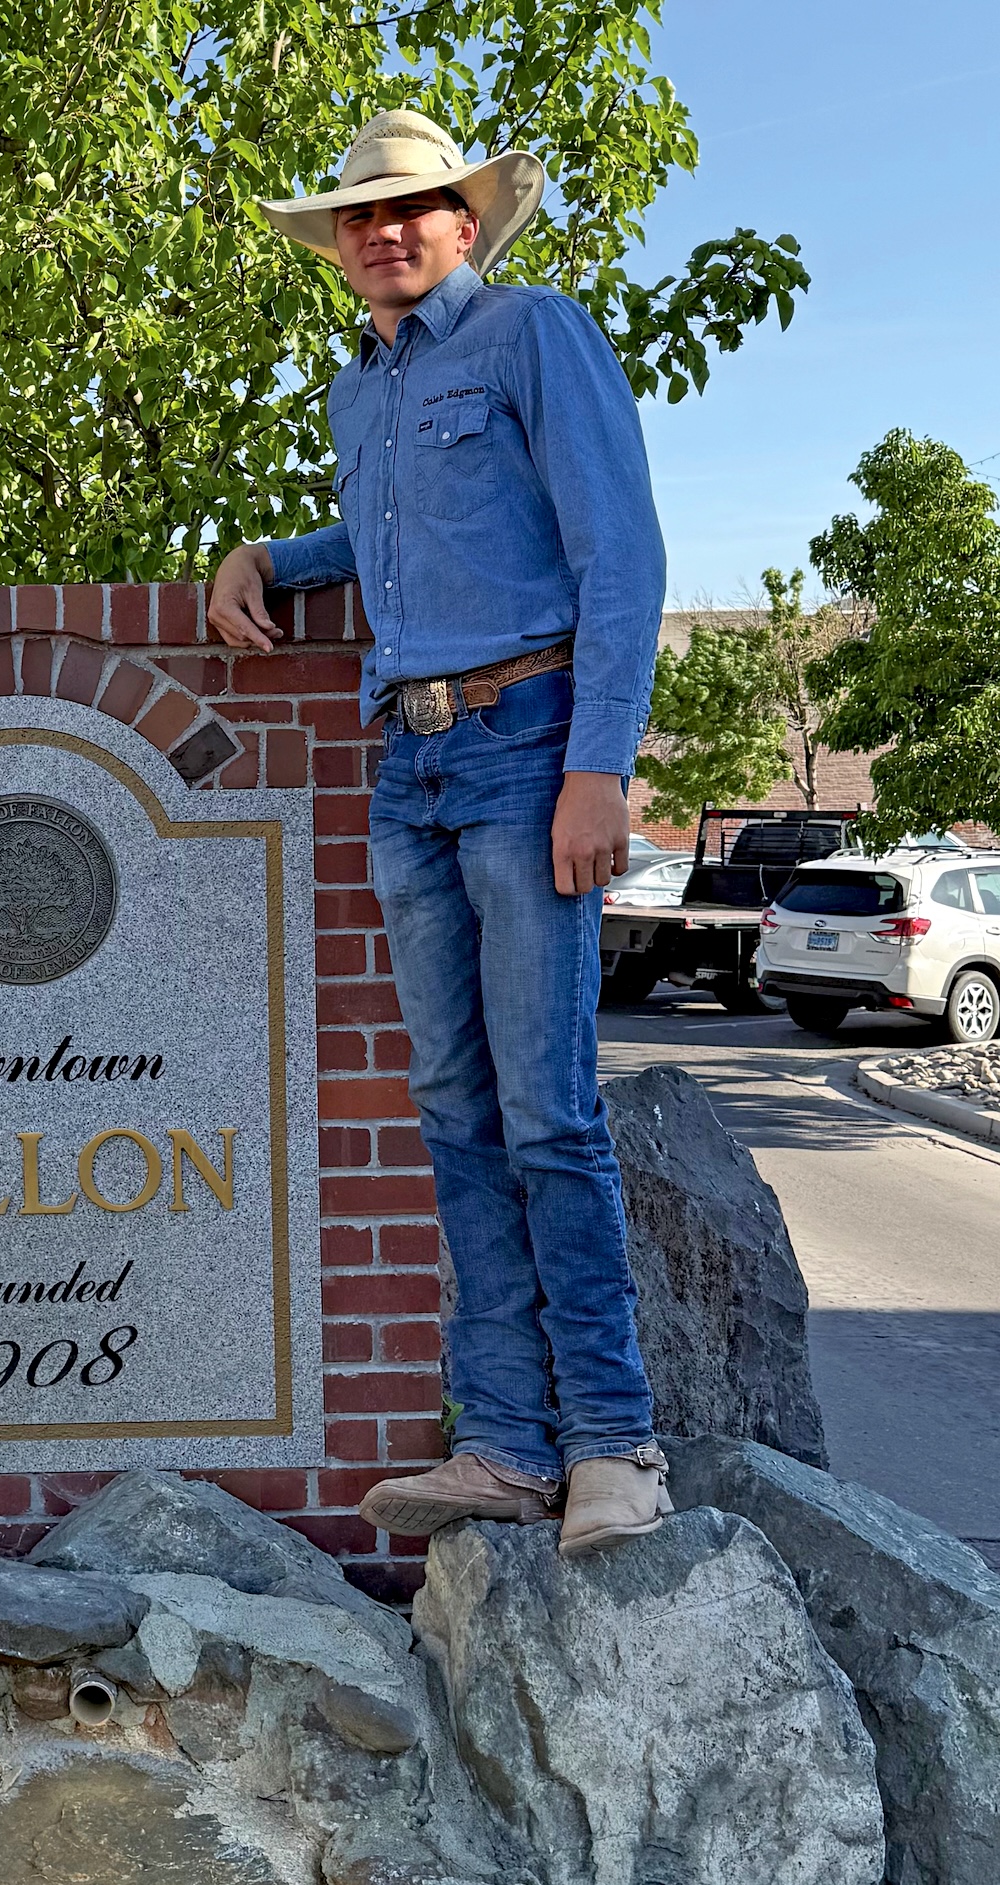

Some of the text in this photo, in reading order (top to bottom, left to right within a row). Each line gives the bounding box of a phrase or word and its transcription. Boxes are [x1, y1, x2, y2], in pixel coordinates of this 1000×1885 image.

[422, 386, 485, 407] Caleb Edgmon
[27, 803, 94, 846] FALLON
[0, 964, 23, 979] OF
[31, 934, 97, 979] NEVADA
